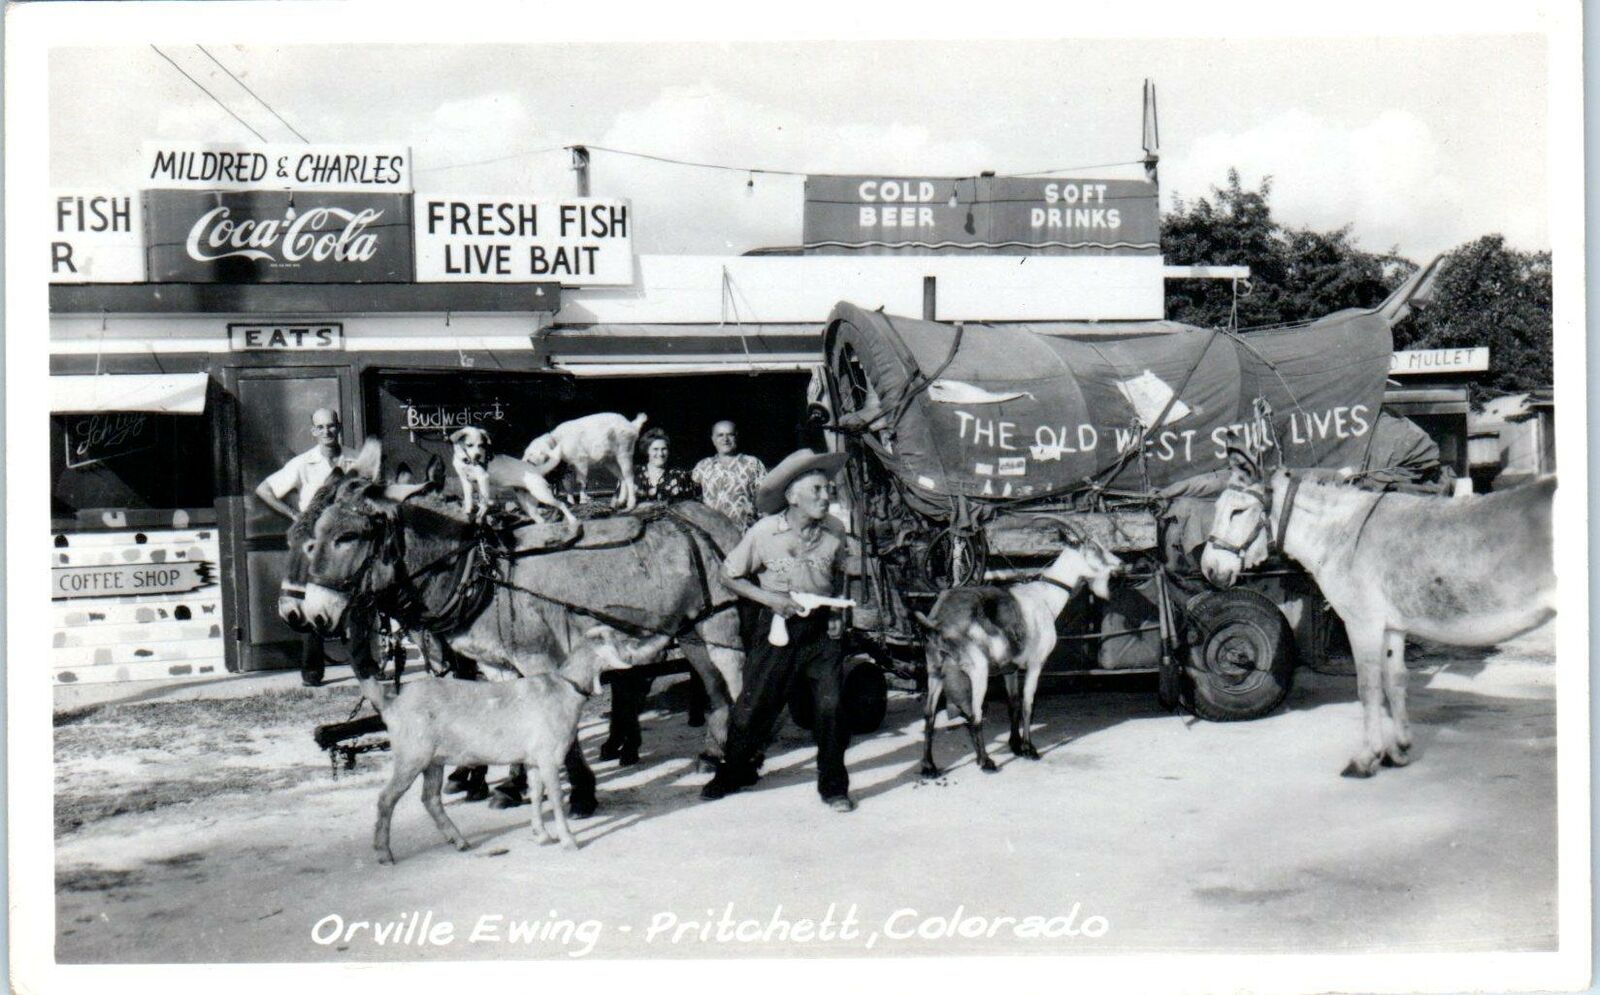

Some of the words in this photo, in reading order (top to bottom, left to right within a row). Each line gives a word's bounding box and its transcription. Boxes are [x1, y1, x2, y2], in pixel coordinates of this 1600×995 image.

[151, 151, 268, 183] MILDRED
[276, 156, 289, 178] &
[295, 153, 404, 184] CHARLES
[859, 181, 935, 203] COLD
[1045, 184, 1107, 203] SOFT
[57, 197, 131, 232] FISH
[428, 202, 537, 236] FRESH
[560, 205, 627, 238] FISH
[859, 207, 935, 227] BEER
[1031, 208, 1121, 228] DRINKS
[186, 204, 385, 263] Coca-Cola
[445, 245, 511, 275] LIVE
[530, 245, 599, 275] BAIT
[245, 328, 333, 347] EATS
[1409, 349, 1475, 369] MULLET
[955, 411, 1014, 449] THE
[1035, 423, 1097, 453] OLD
[1292, 404, 1369, 444] LIVES
[60, 571, 123, 591] COFFEE
[133, 569, 181, 588] SHOP
